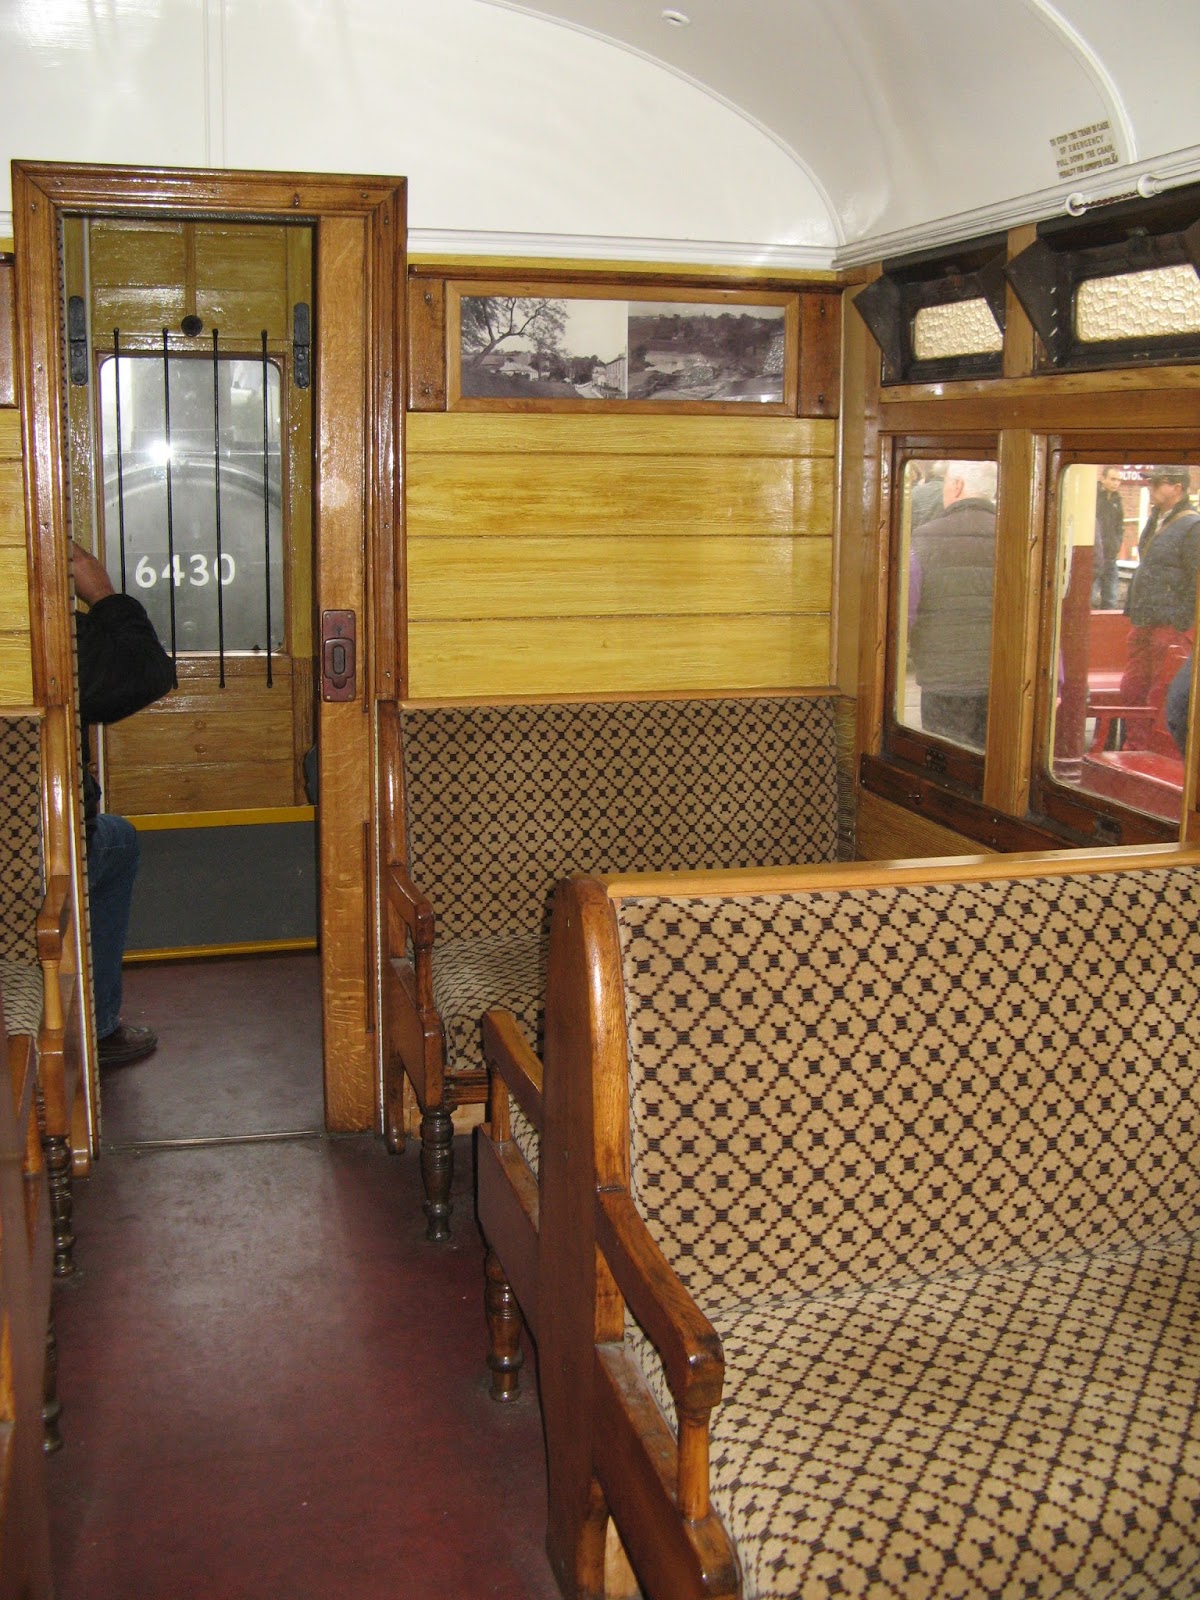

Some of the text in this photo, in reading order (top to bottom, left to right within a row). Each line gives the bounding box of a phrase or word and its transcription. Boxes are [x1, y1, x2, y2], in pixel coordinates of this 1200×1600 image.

[1056, 135, 1068, 144] STOP
[1068, 131, 1078, 140] THE
[1078, 126, 1092, 137] TRAIN
[1097, 121, 1110, 131] CASE
[1059, 135, 1104, 155] OF EMERGENCY
[1056, 158, 1068, 168] PULL
[1069, 153, 1084, 164] DOWN
[1086, 150, 1095, 158] THE
[1059, 167, 1076, 179] PENALTY
[135, 553, 235, 588] 6430
